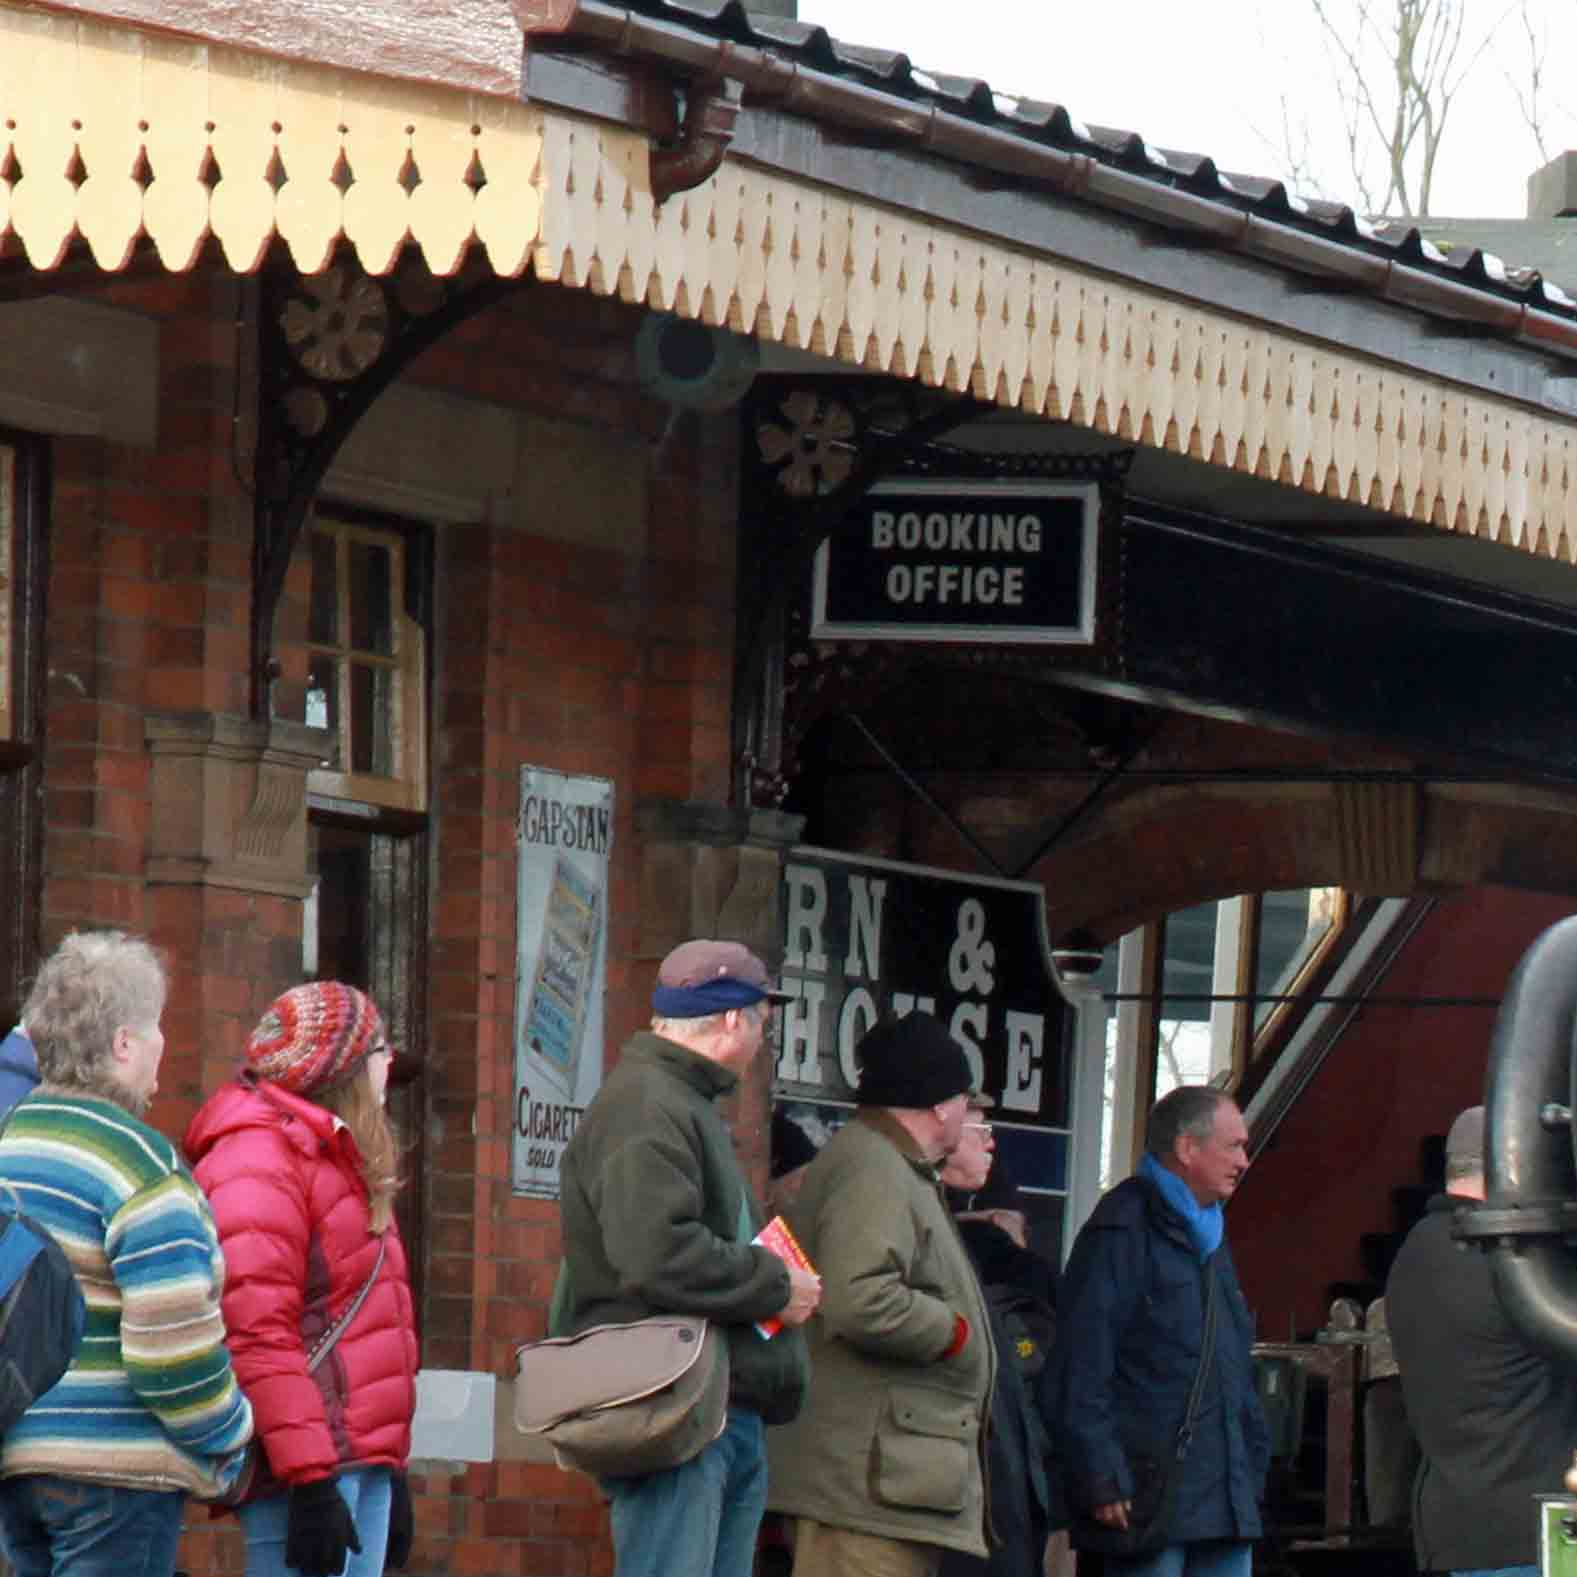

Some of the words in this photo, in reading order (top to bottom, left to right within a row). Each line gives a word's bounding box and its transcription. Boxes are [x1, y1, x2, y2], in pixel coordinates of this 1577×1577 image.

[871, 511, 1042, 552] BOOKING
[886, 565, 1024, 605] OFFICE
[527, 1147, 555, 1169] SOLD
